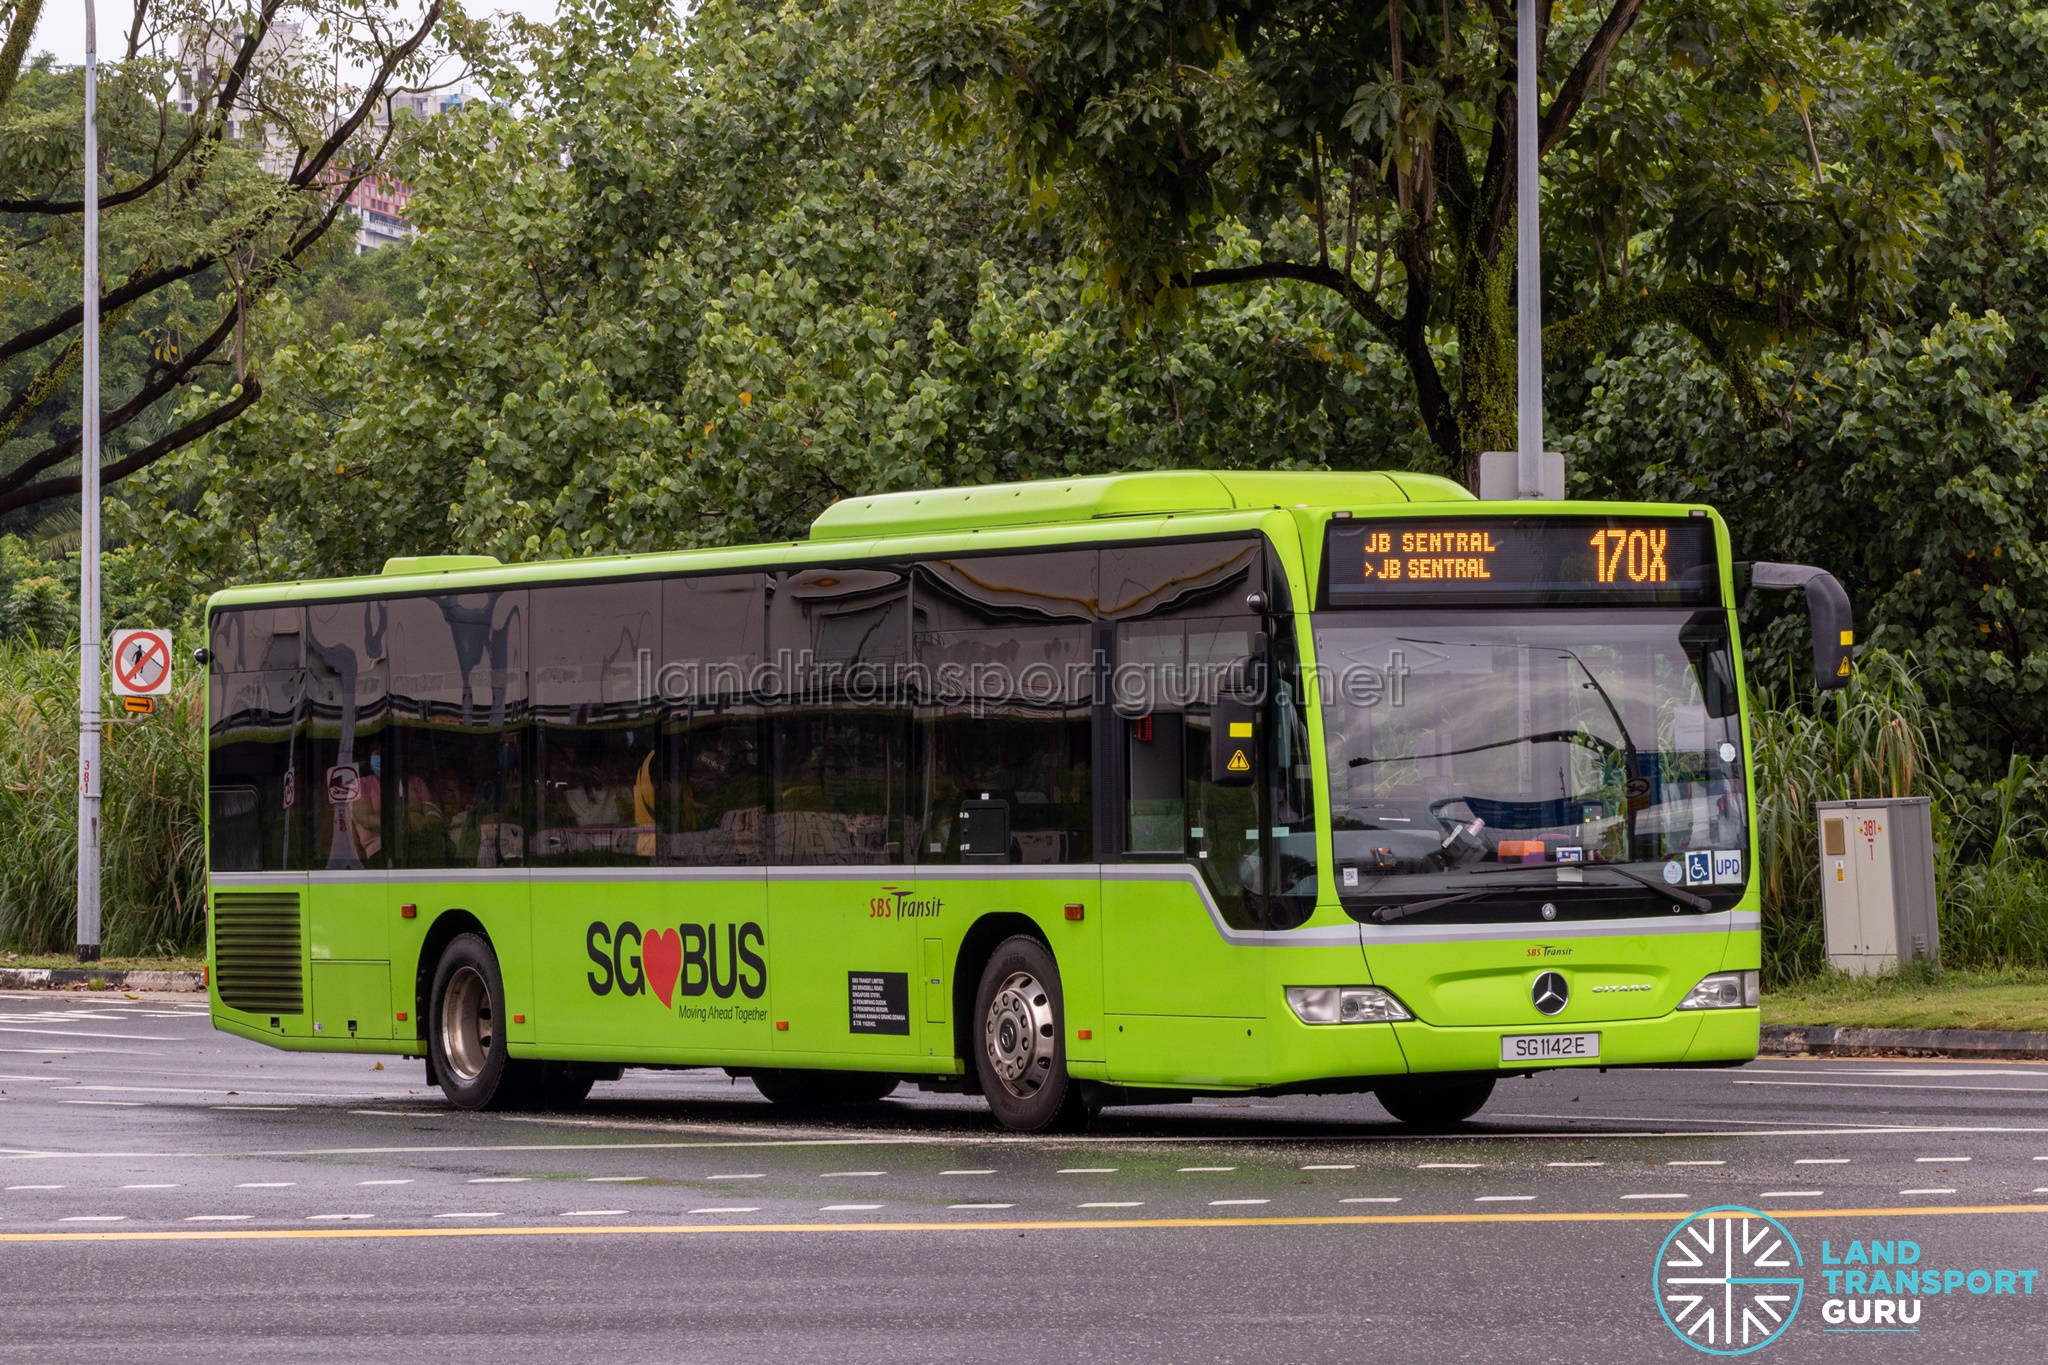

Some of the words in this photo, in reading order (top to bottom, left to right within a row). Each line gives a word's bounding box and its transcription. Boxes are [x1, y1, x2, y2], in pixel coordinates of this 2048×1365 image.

[1365, 532, 1391, 553] JB
[1402, 531, 1496, 553] SENTRAL
[1590, 528, 1667, 583] 170X
[1407, 558, 1491, 579] SENTRAL
[1863, 820, 1877, 837] 381
[1716, 858, 1740, 876] UPD
[869, 898, 891, 918] SBS
[890, 891, 945, 922] Transit
[1527, 948, 1541, 957] SBS
[1542, 945, 1574, 957] Transit
[1592, 983, 1652, 993] CITARO
[679, 1005, 707, 1022] Moving
[707, 1005, 733, 1020] Ahead
[734, 1006, 768, 1024] Together
[1516, 1036, 1586, 1056] SG1142E
